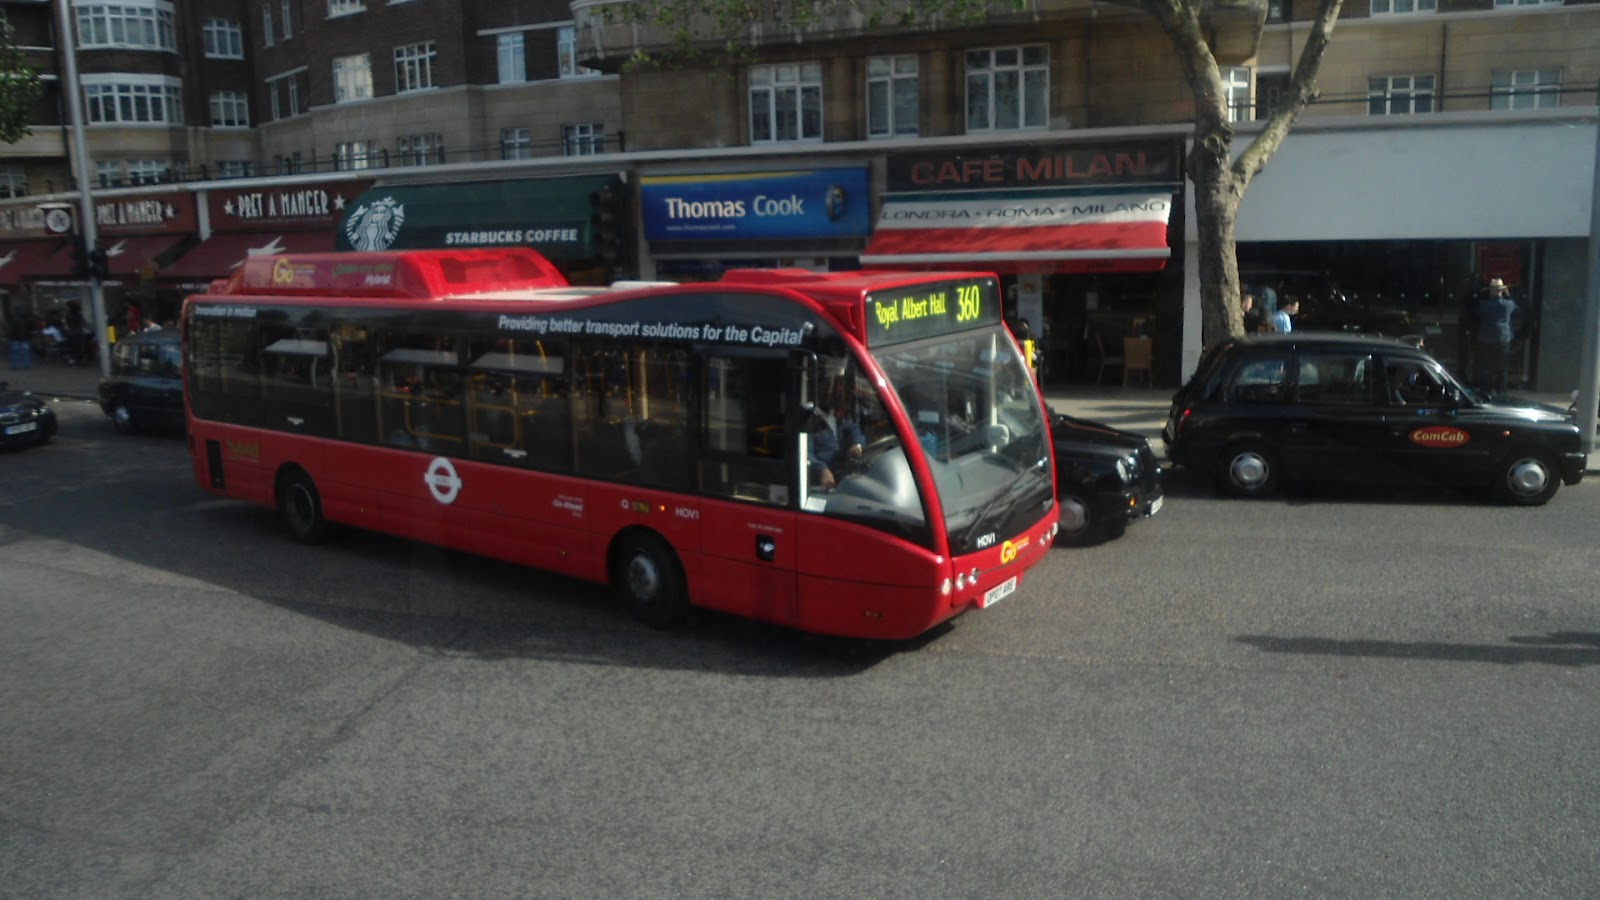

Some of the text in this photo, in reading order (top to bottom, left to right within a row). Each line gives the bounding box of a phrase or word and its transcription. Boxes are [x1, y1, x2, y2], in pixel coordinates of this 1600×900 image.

[911, 151, 1146, 185] CAFÉ MILAN
[238, 190, 329, 218] PRET A MANGER
[665, 194, 805, 219] Thomas Cook
[882, 201, 1165, 220] LONDRA ROMA MILANO
[445, 229, 577, 244] STARBUCKS COFFEE
[365, 273, 391, 286] Hybrid
[875, 292, 946, 330] Royal Albert Hall
[956, 285, 980, 321] 360
[498, 315, 804, 347] Providing better transport solutions for the Capital
[1413, 430, 1465, 442] ComCab
[976, 532, 996, 549] HOV1
